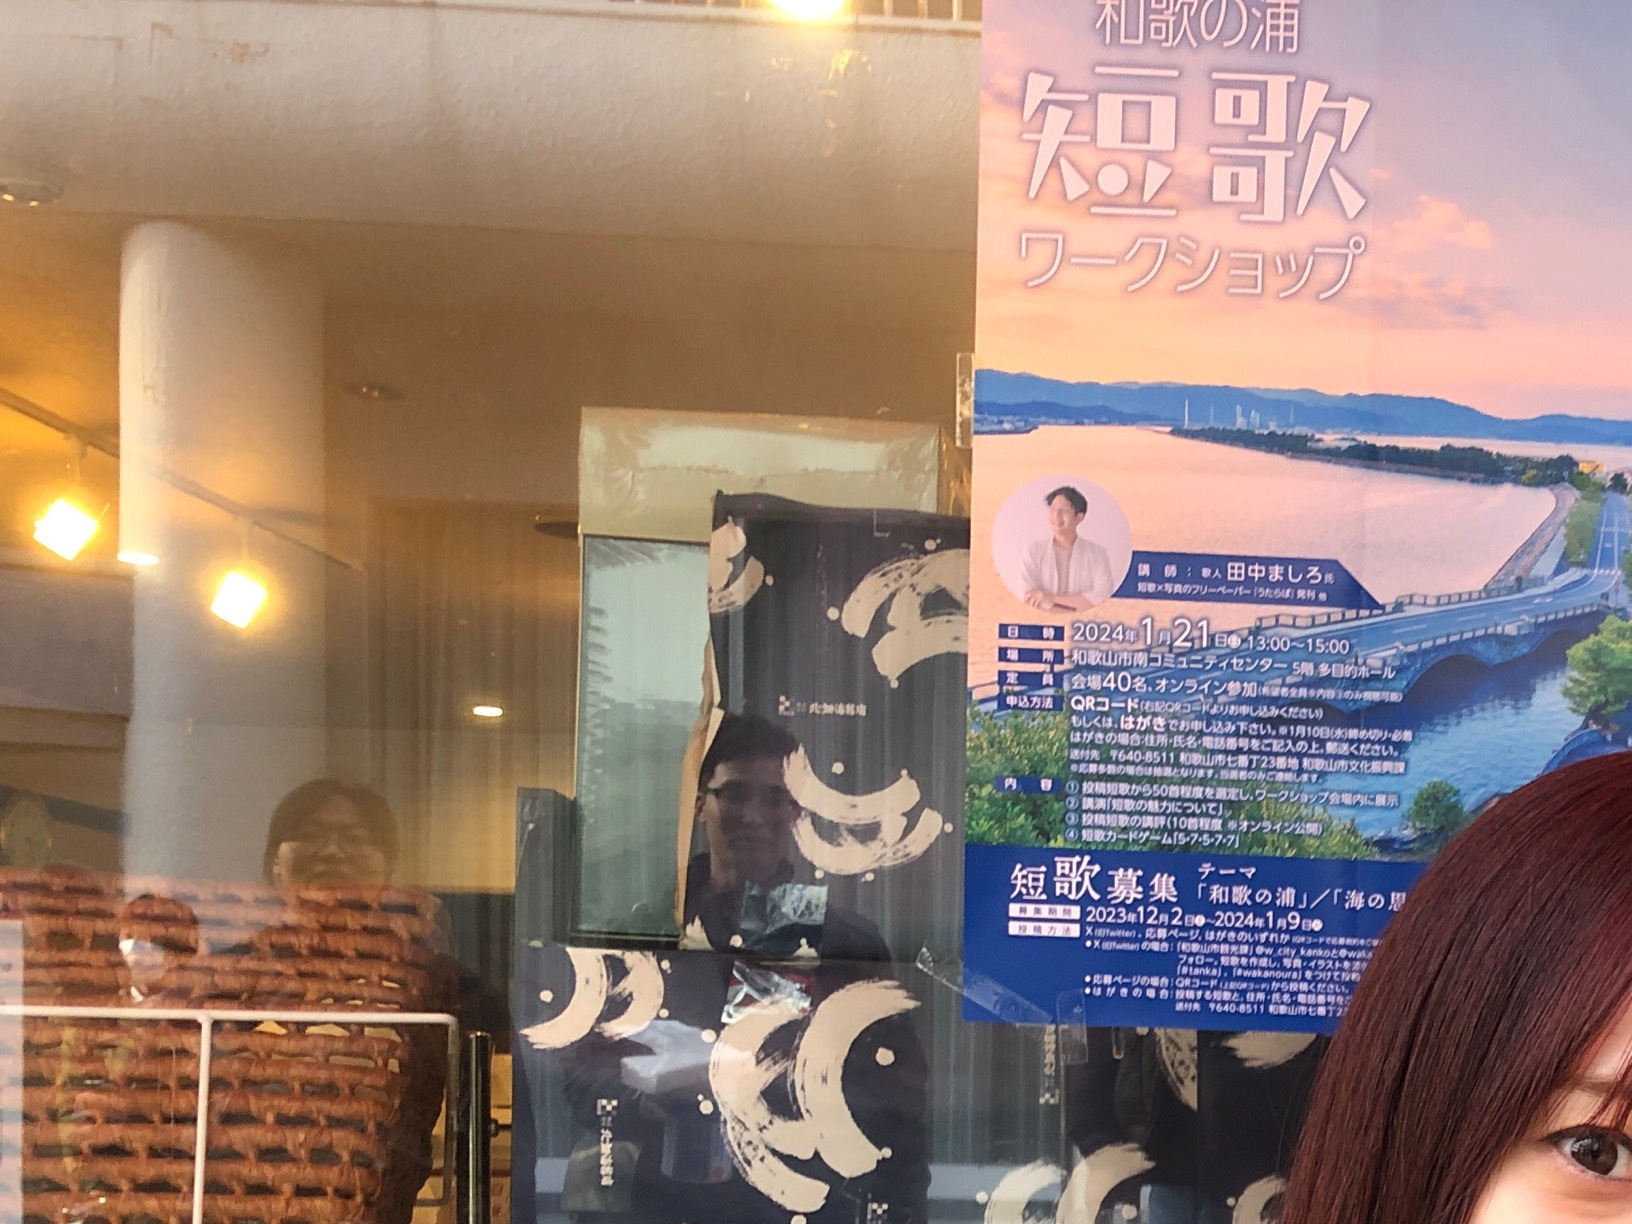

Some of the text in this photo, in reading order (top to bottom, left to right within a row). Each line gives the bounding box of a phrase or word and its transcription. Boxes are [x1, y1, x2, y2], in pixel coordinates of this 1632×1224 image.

[1095, 0, 1300, 53] 和歌の浦
[1021, 65, 1372, 222] 短歌
[1020, 232, 1367, 300] ワークショップ
[1071, 650, 1289, 672] 和歌山市南コミュニティセンター
[1318, 662, 1397, 681] 多目的ホール
[1006, 696, 1054, 710] 申込方法
[1009, 854, 1179, 905] 短歌募集
[1197, 862, 1257, 880] テーマ
